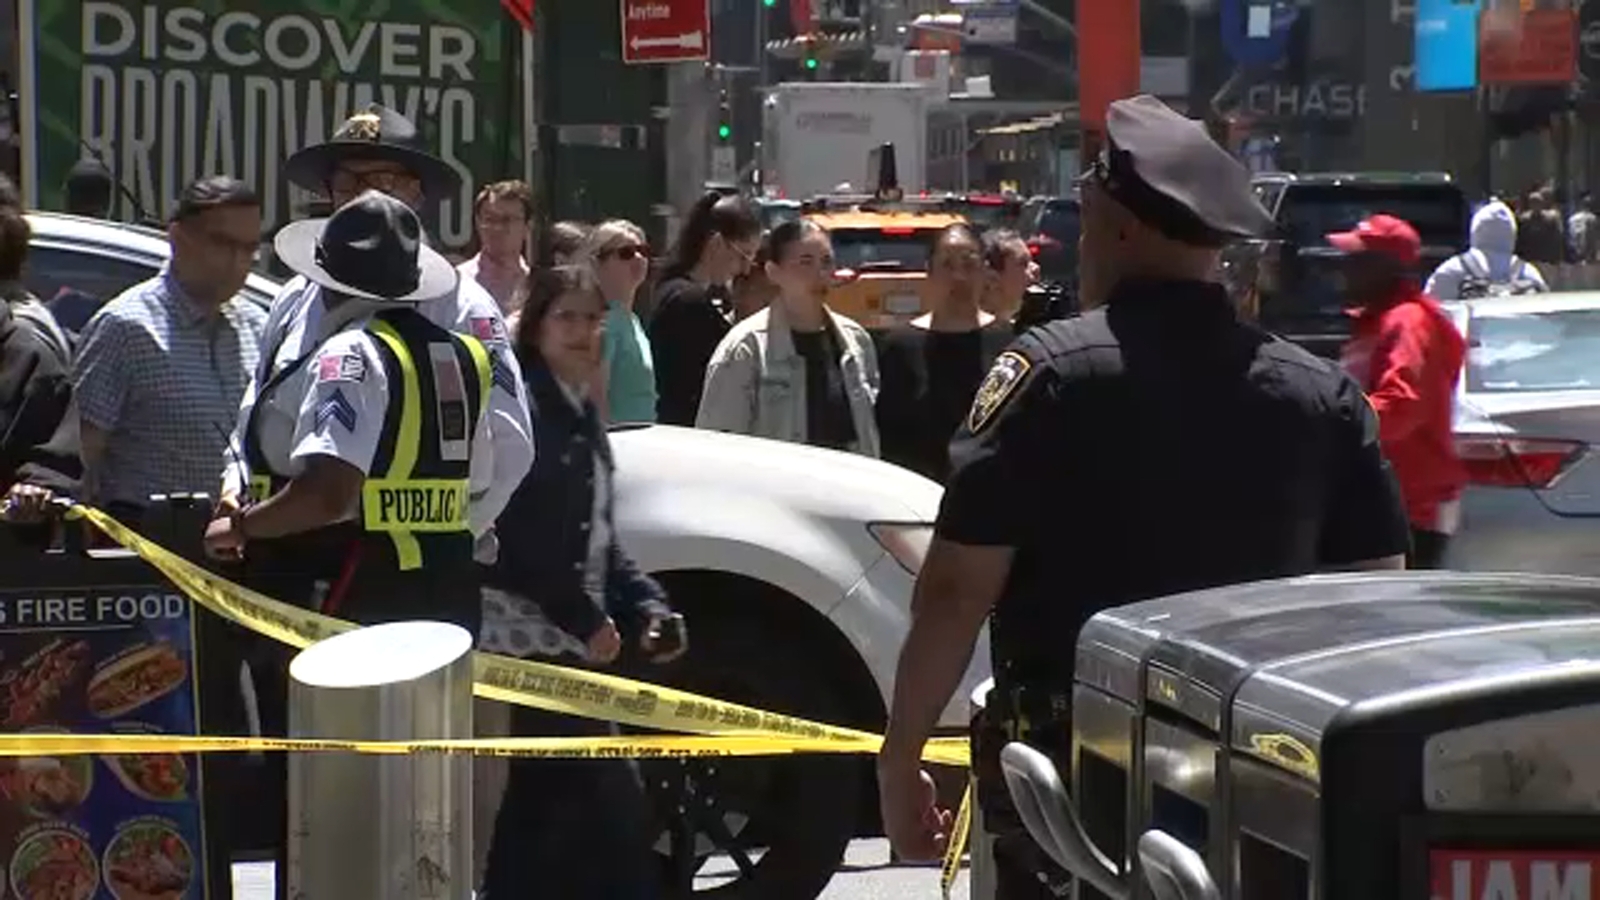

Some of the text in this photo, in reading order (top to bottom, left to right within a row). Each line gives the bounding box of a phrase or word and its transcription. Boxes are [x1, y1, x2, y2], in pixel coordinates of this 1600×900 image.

[627, 2, 671, 21] Anytime
[81, 4, 474, 81] DISCOVER
[80, 63, 474, 248] BROADW'S
[378, 488, 457, 523] PUBLIC
[16, 597, 87, 623] FIRE
[96, 594, 184, 621] FOOD
